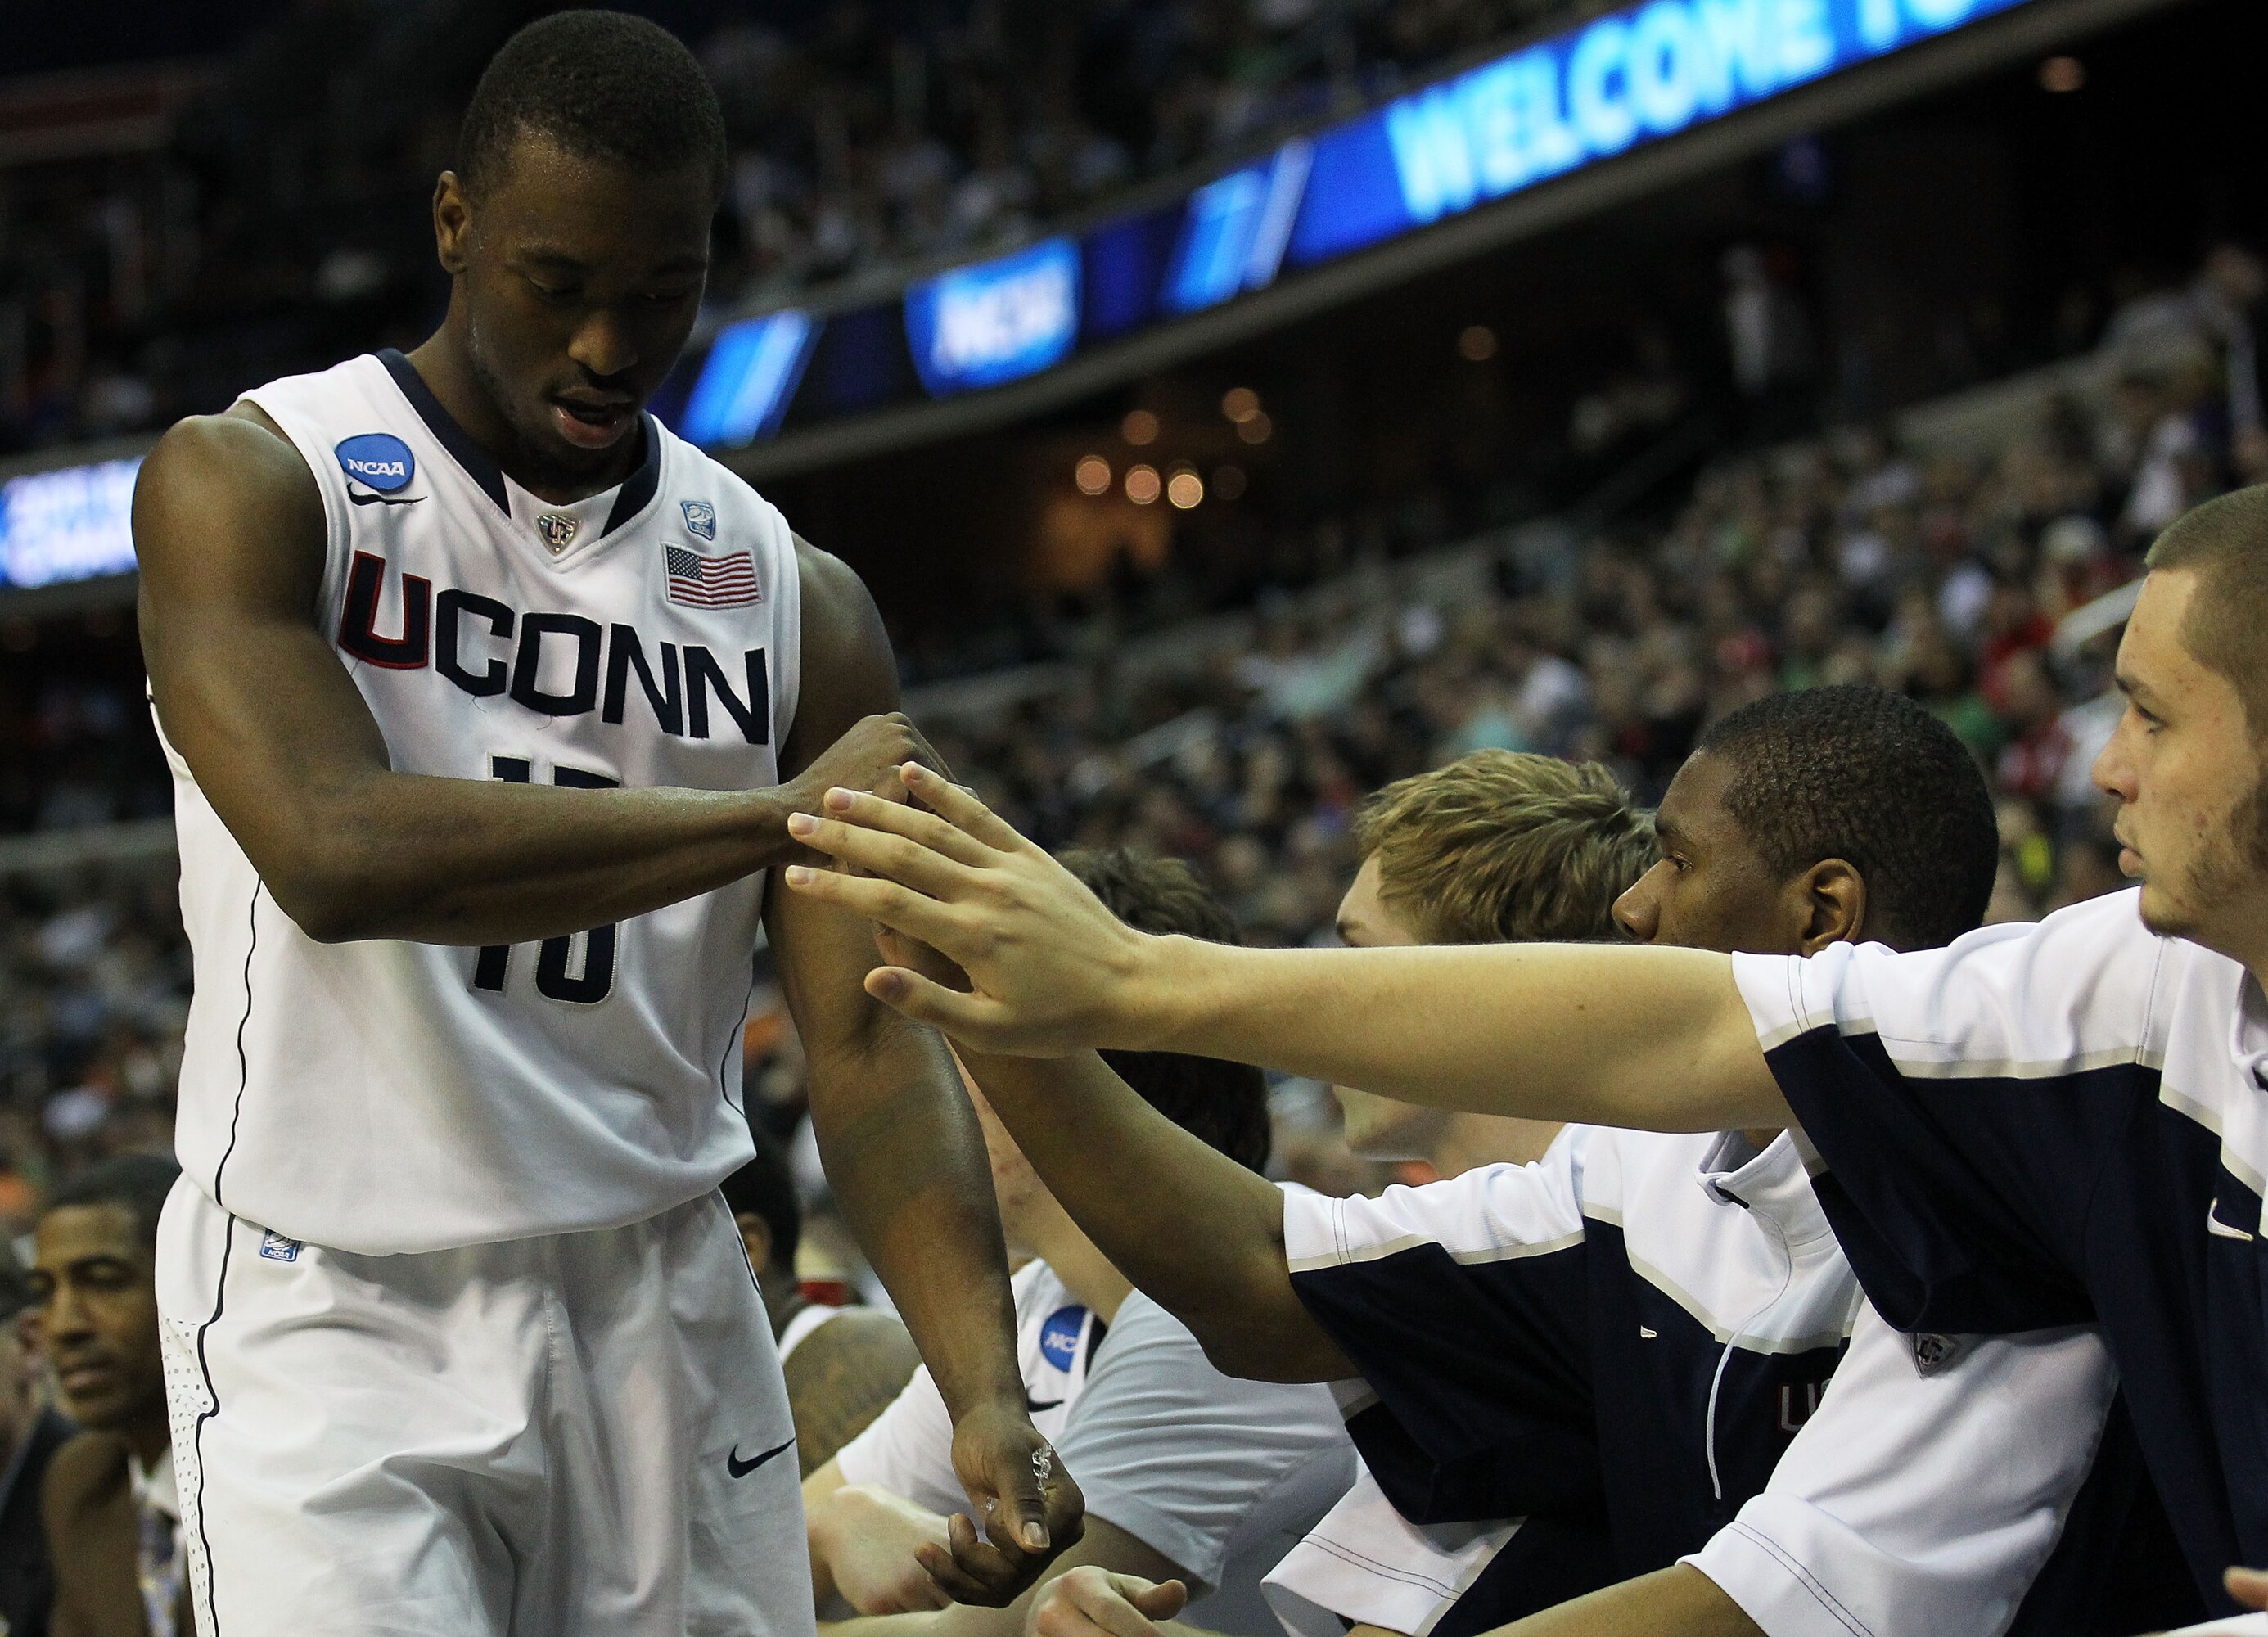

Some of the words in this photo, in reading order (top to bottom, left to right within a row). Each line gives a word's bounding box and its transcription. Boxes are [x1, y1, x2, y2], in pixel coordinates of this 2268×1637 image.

[1385, 0, 1836, 223] WELCOME
[347, 458, 405, 476] NCAA
[338, 550, 769, 746] UCONN
